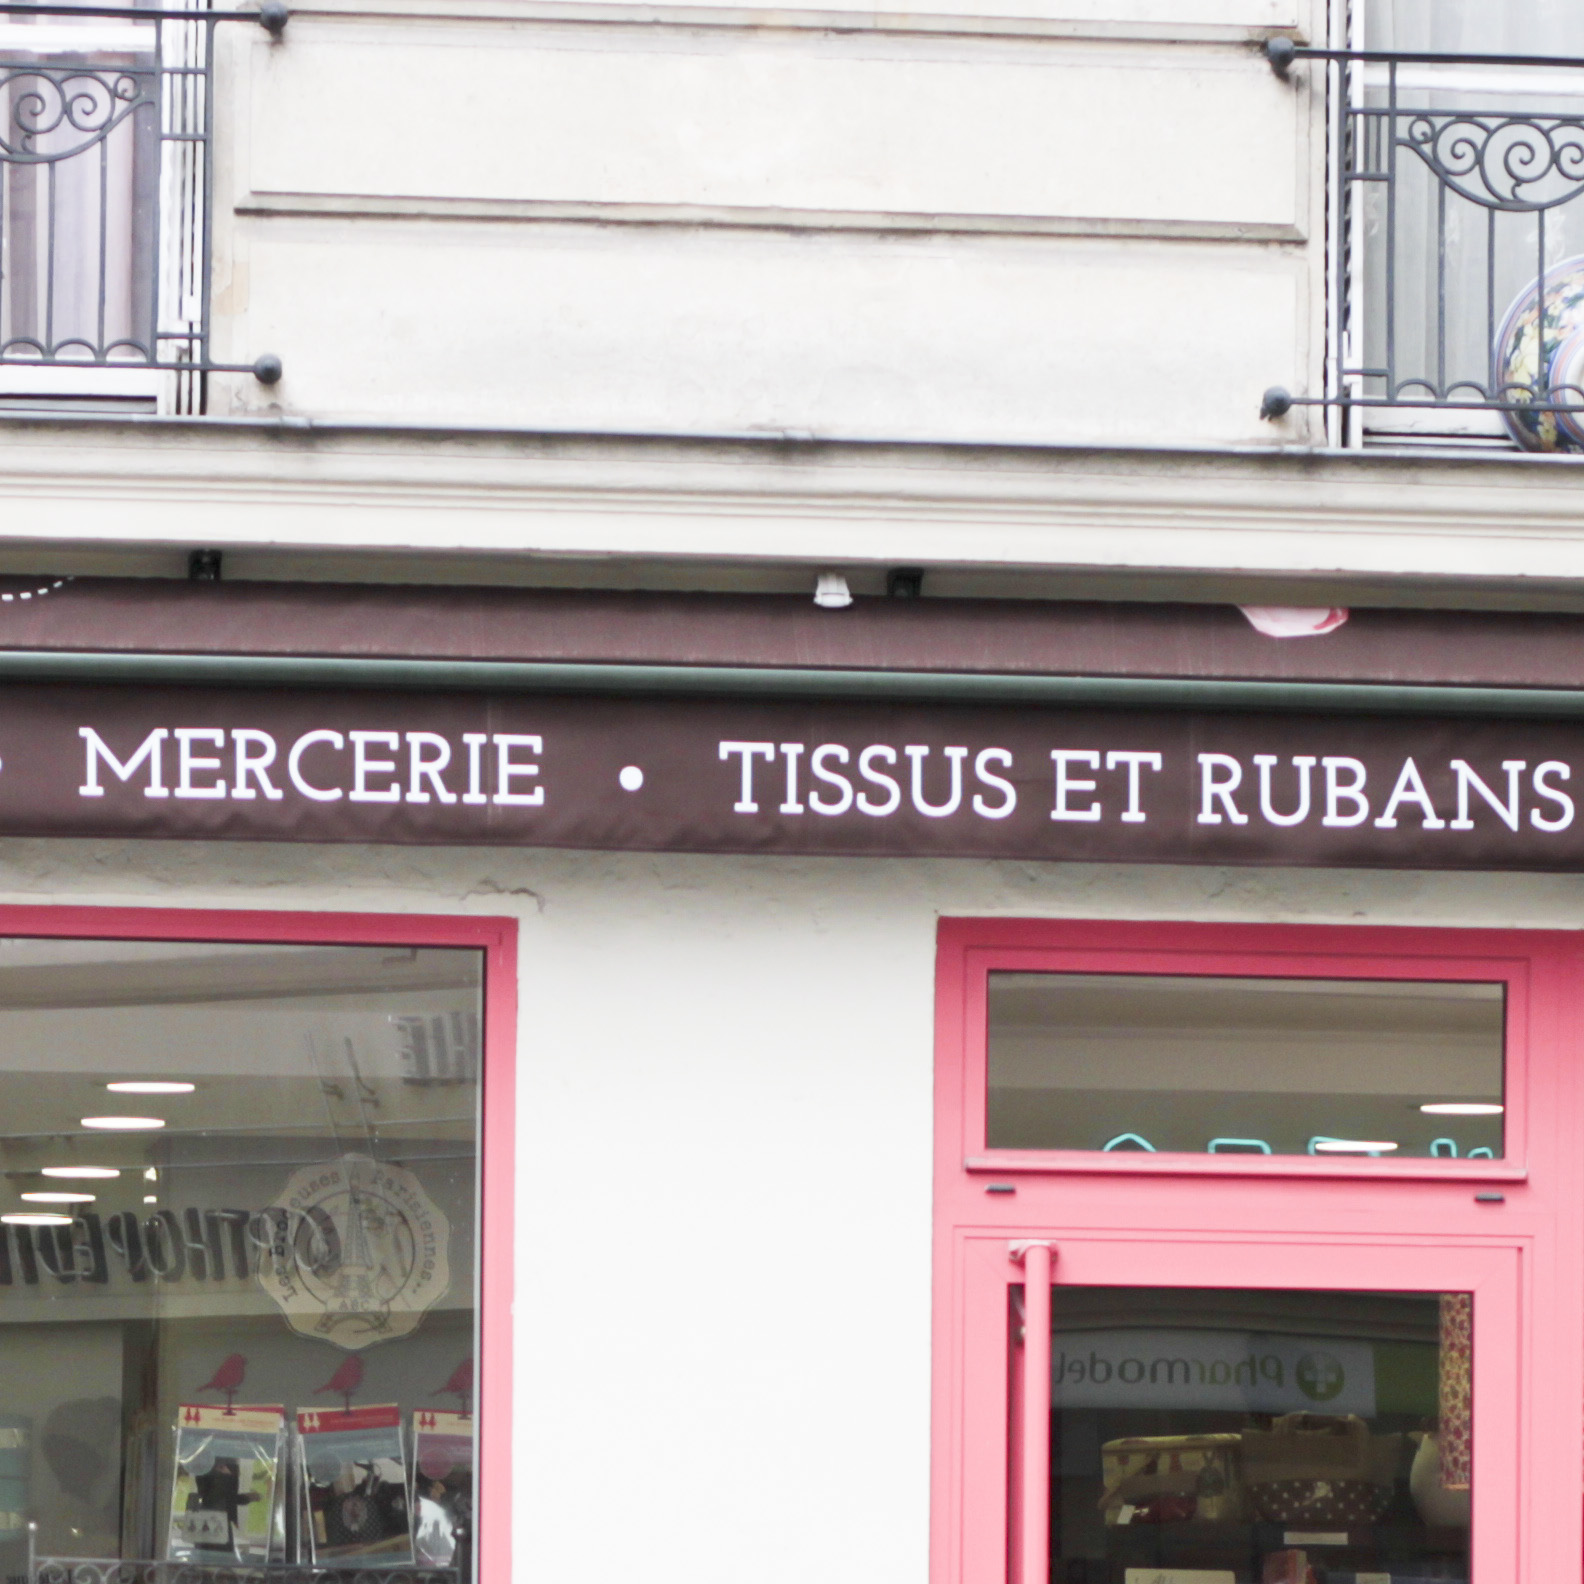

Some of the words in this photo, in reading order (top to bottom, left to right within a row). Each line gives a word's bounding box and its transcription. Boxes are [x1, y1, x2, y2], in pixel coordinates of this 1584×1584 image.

[77, 726, 547, 807] MERCERIE
[717, 741, 1018, 821] TISSUS
[1049, 749, 1164, 824] ET
[1196, 753, 1576, 833] RUBANS
